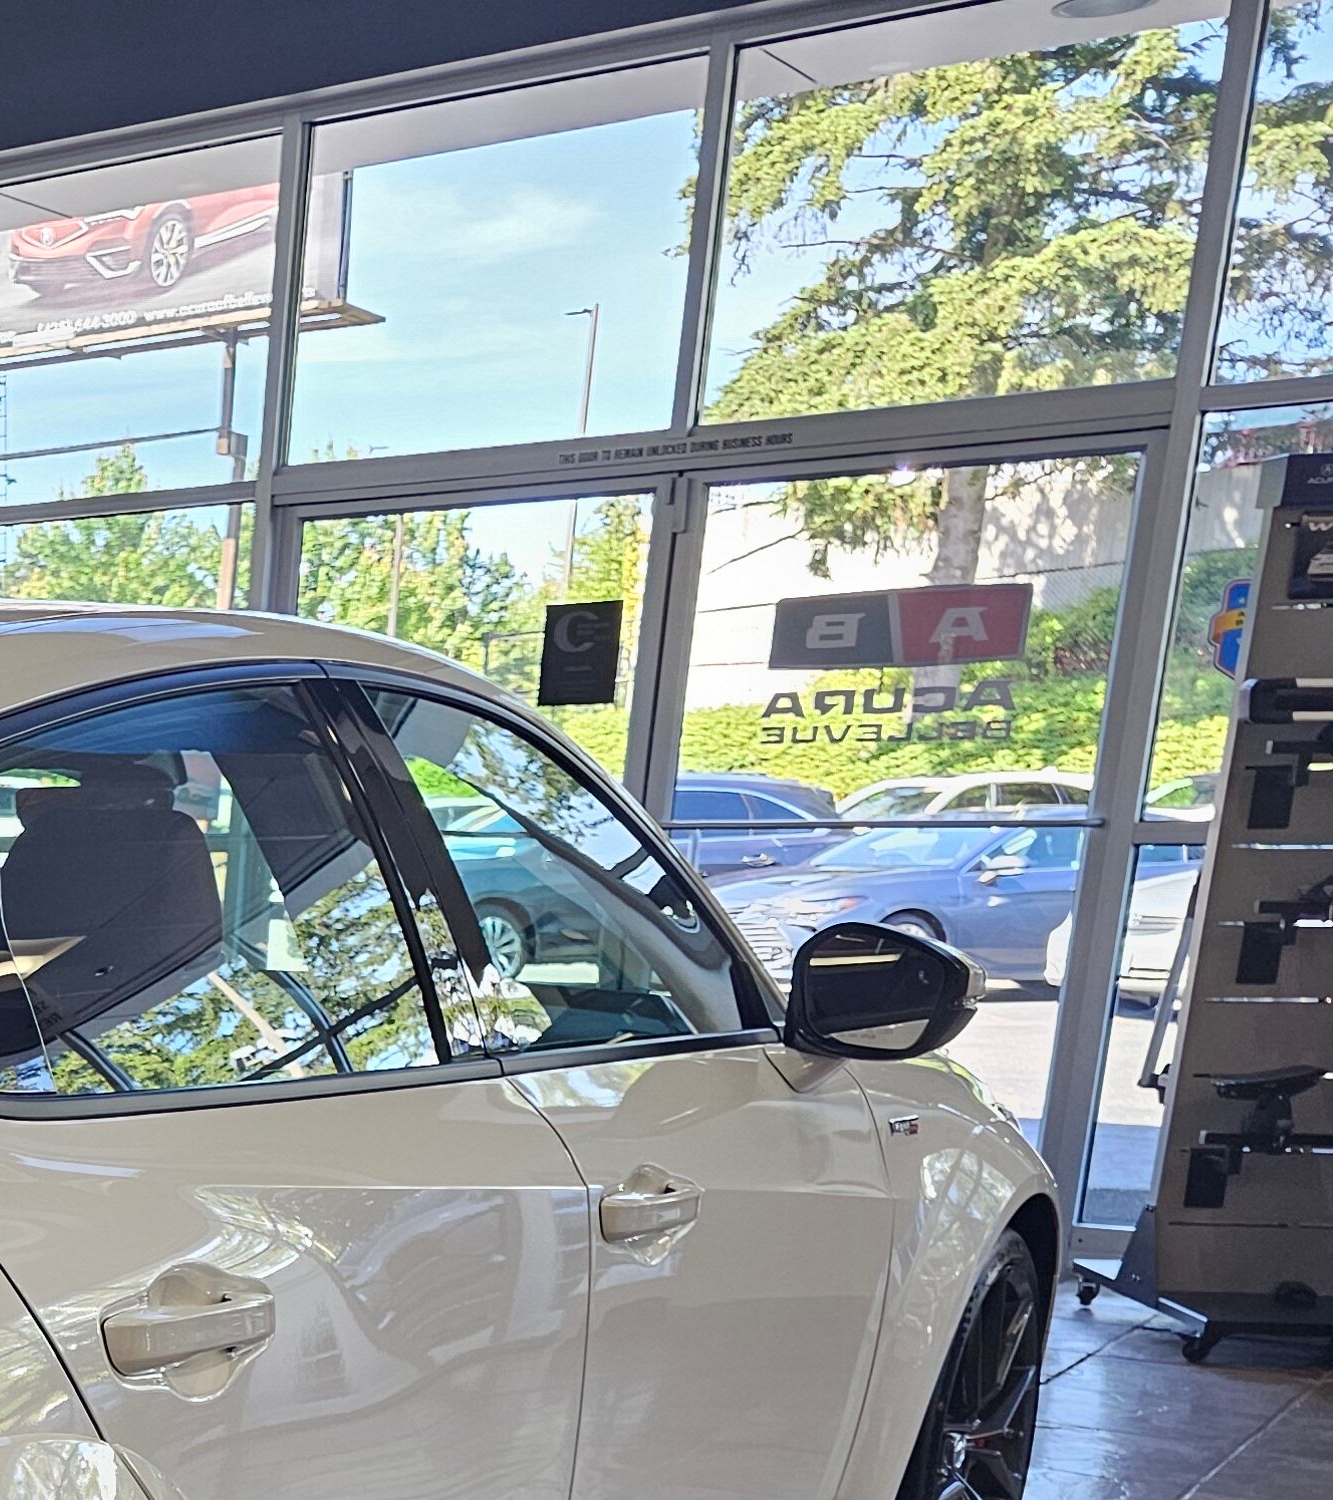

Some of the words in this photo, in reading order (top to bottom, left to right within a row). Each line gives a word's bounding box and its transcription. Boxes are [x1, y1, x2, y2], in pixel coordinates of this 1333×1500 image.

[559, 453, 575, 464] THIS
[578, 451, 598, 463] DOOR
[601, 450, 611, 461] TO
[614, 447, 643, 460] REMAIN
[646, 443, 687, 457] UNLOCKED
[689, 440, 719, 453] DURING
[721, 435, 763, 450] BUSINESS
[764, 432, 794, 446] HOURS
